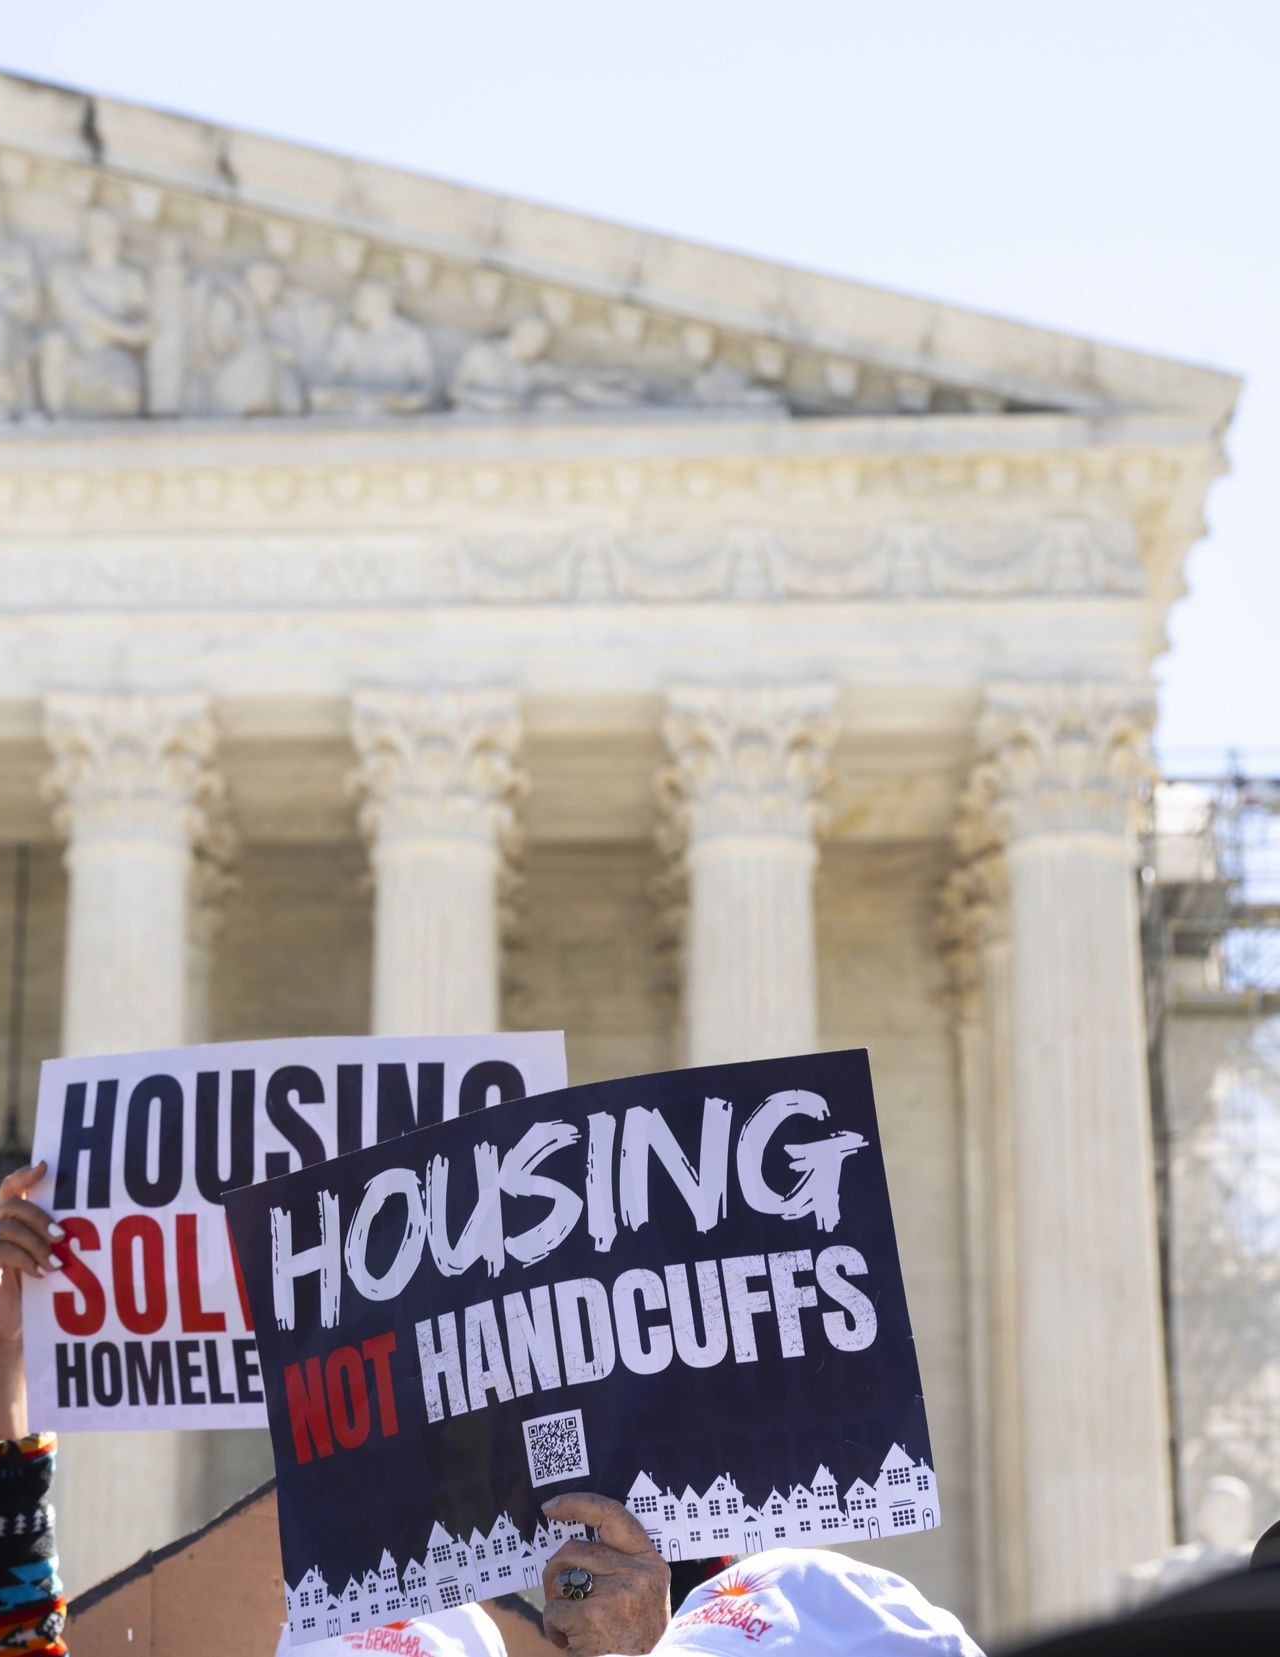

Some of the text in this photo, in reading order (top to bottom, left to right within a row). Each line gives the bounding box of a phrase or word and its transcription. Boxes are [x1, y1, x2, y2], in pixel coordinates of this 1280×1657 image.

[53, 1213, 255, 1336] SOL
[270, 1089, 869, 1330] HOUSING
[55, 1338, 265, 1408] HOMELE
[283, 1245, 878, 1464] NOT HANDCUFFS
